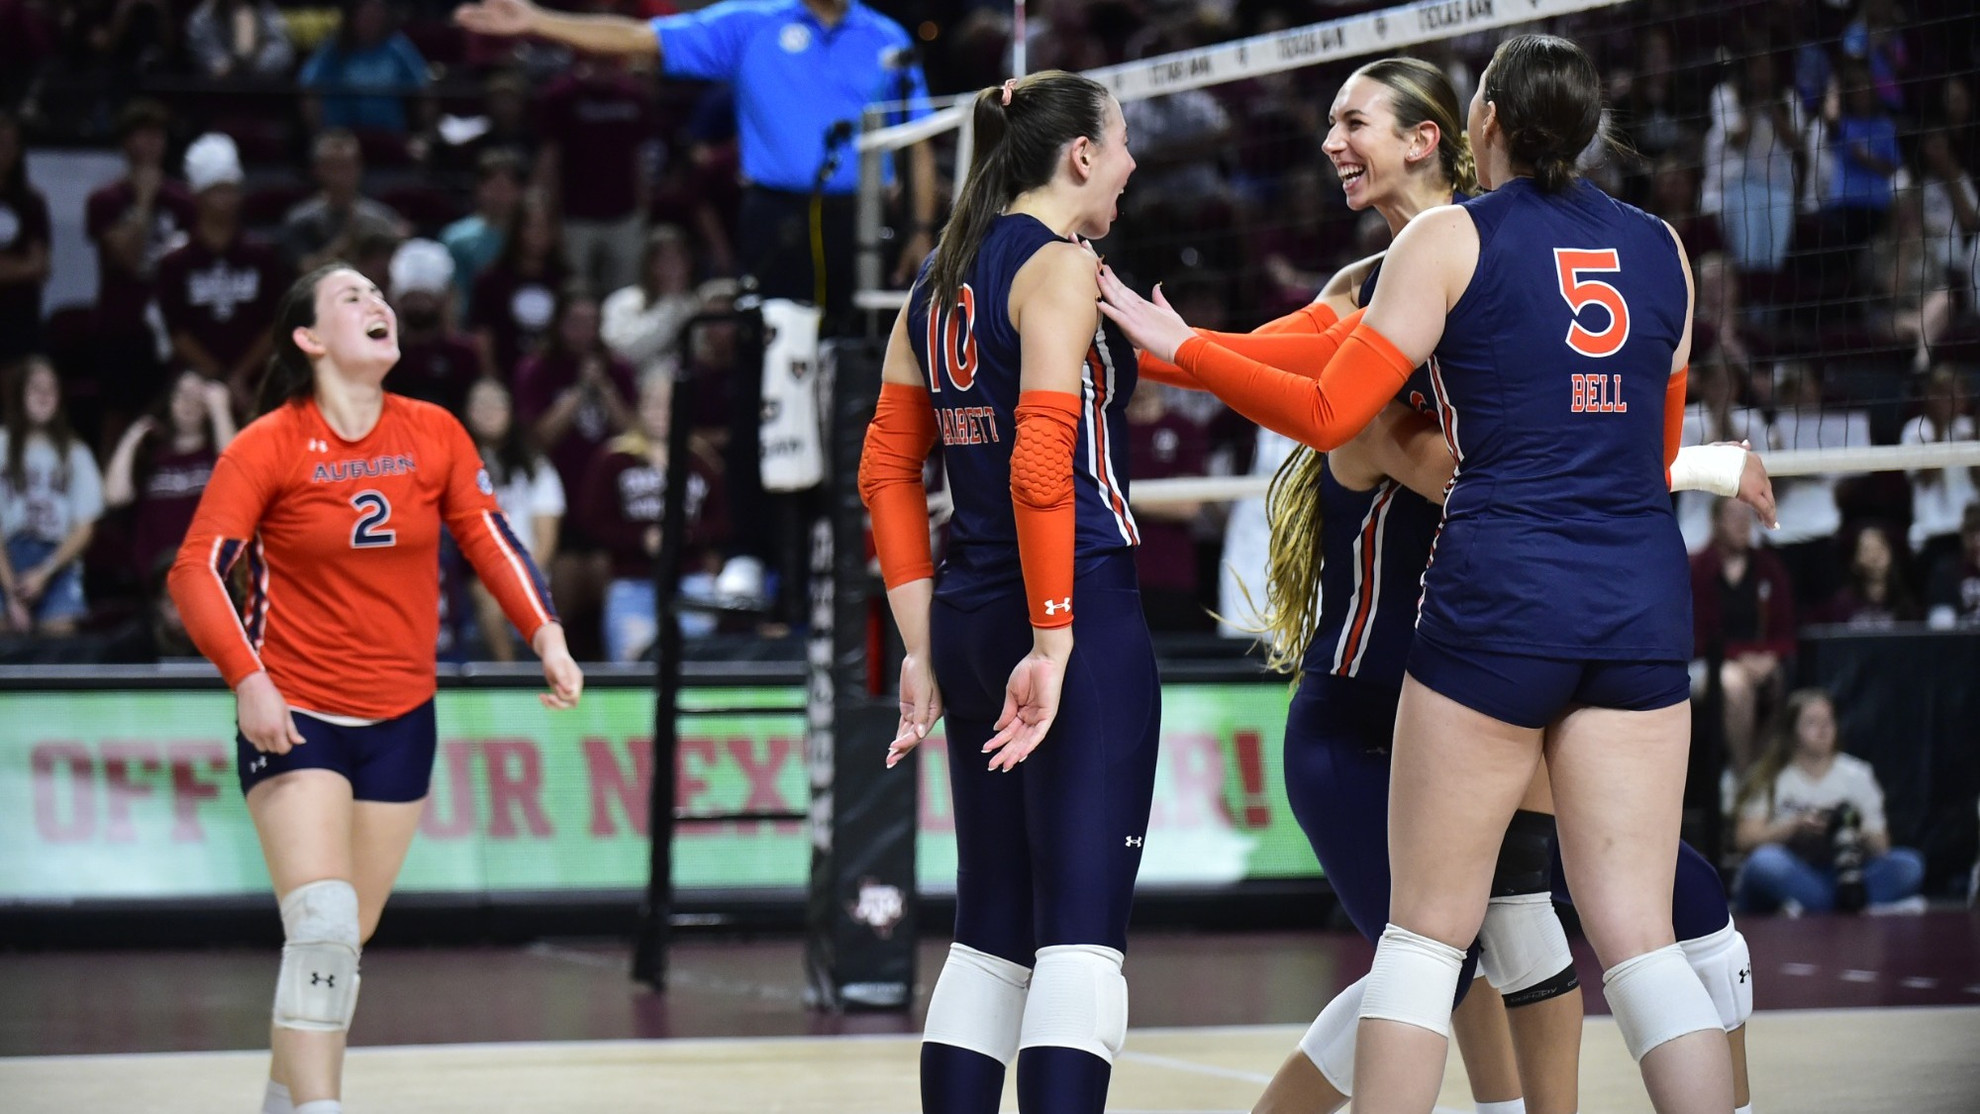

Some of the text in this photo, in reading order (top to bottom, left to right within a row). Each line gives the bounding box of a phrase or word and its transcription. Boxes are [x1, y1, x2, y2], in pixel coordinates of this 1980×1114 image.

[926, 282, 979, 393] 10
[1553, 247, 1630, 358] 5
[1571, 374, 1627, 413] BELL
[312, 453, 416, 483] AUBURN
[350, 489, 396, 549] 2
[30, 738, 228, 844] OFF
[580, 736, 808, 836] NEX
